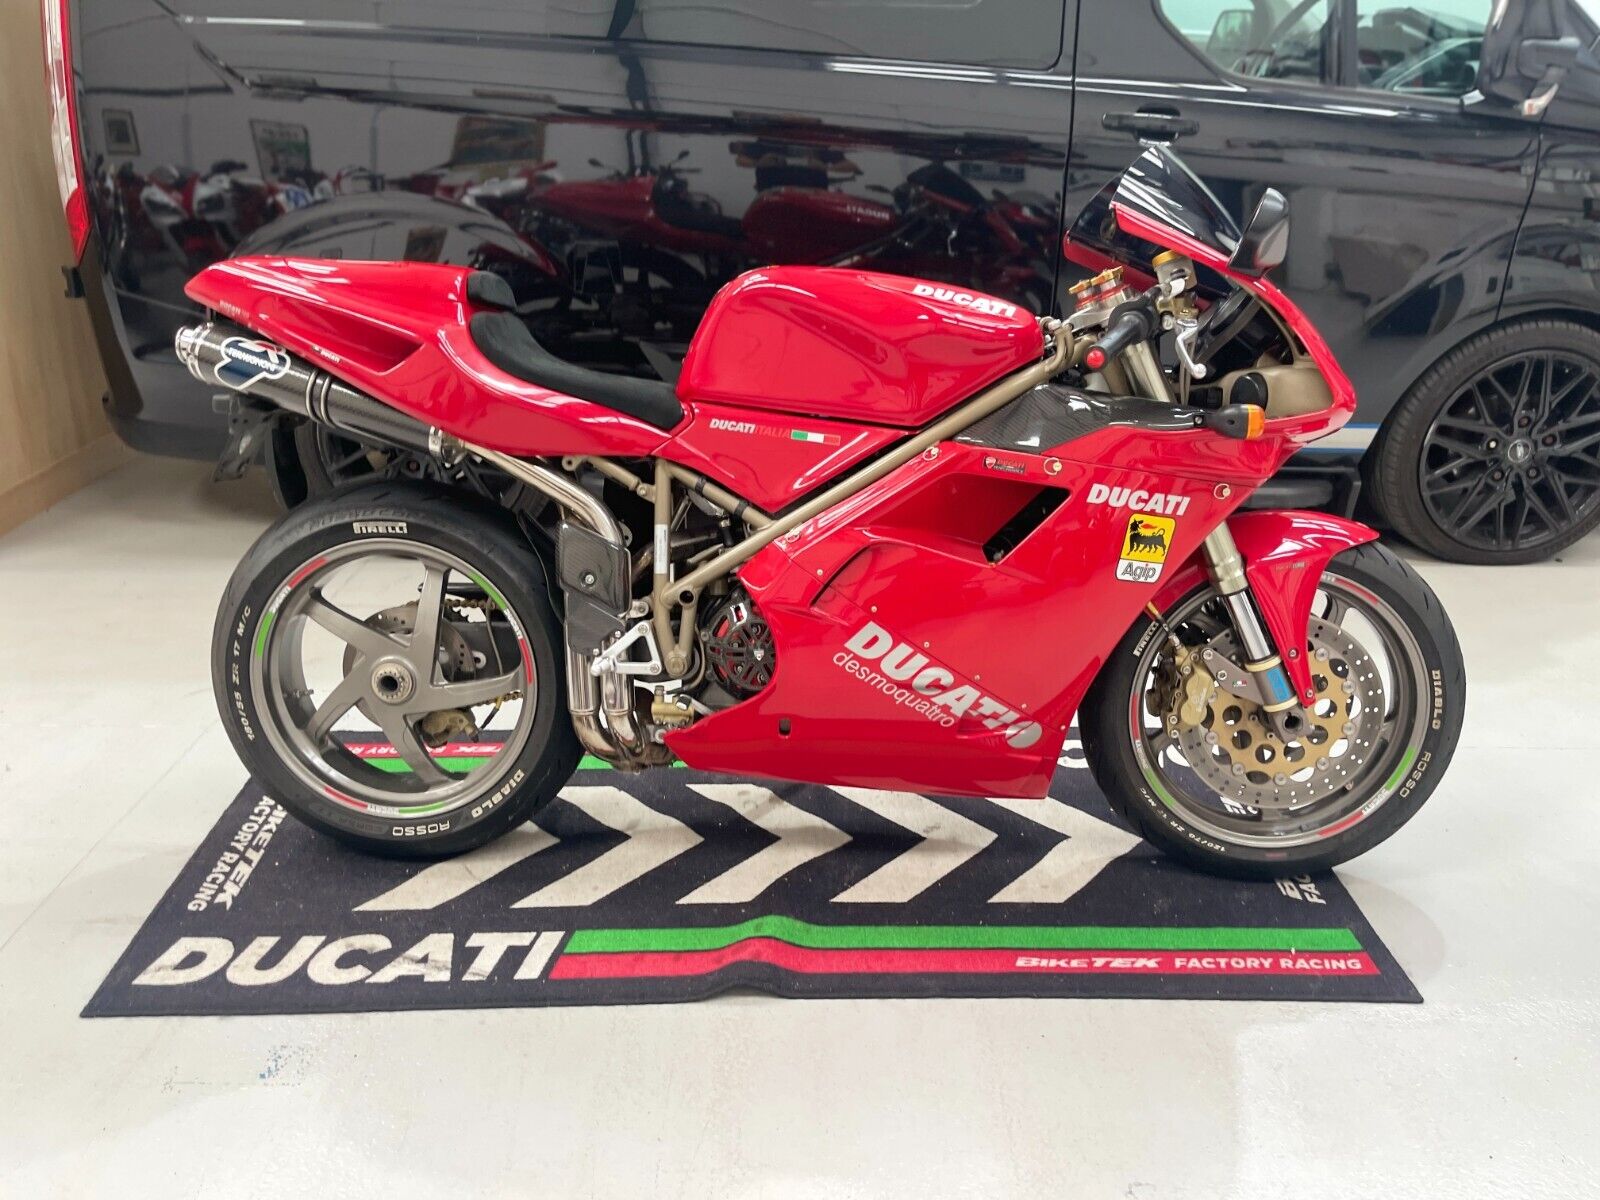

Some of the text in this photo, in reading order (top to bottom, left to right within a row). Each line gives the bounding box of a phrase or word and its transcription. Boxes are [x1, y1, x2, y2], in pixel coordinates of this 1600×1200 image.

[912, 284, 1017, 318] DUCATI
[709, 418, 791, 438] DUCATI ITALIA
[1086, 483, 1191, 516] DUCATI
[353, 521, 408, 535] PIRELLI
[1121, 561, 1157, 581] Agip
[833, 651, 955, 727] desmoquattro
[1399, 669, 1443, 798] DIABLO ROSSO
[392, 769, 525, 836] DIABLO ROSSO
[187, 795, 276, 911] ACTORY RACING
[214, 804, 288, 911] IKETEK
[131, 931, 566, 986] DUCATI
[1015, 956, 1362, 970] BIKETEK FACTORY RACING
